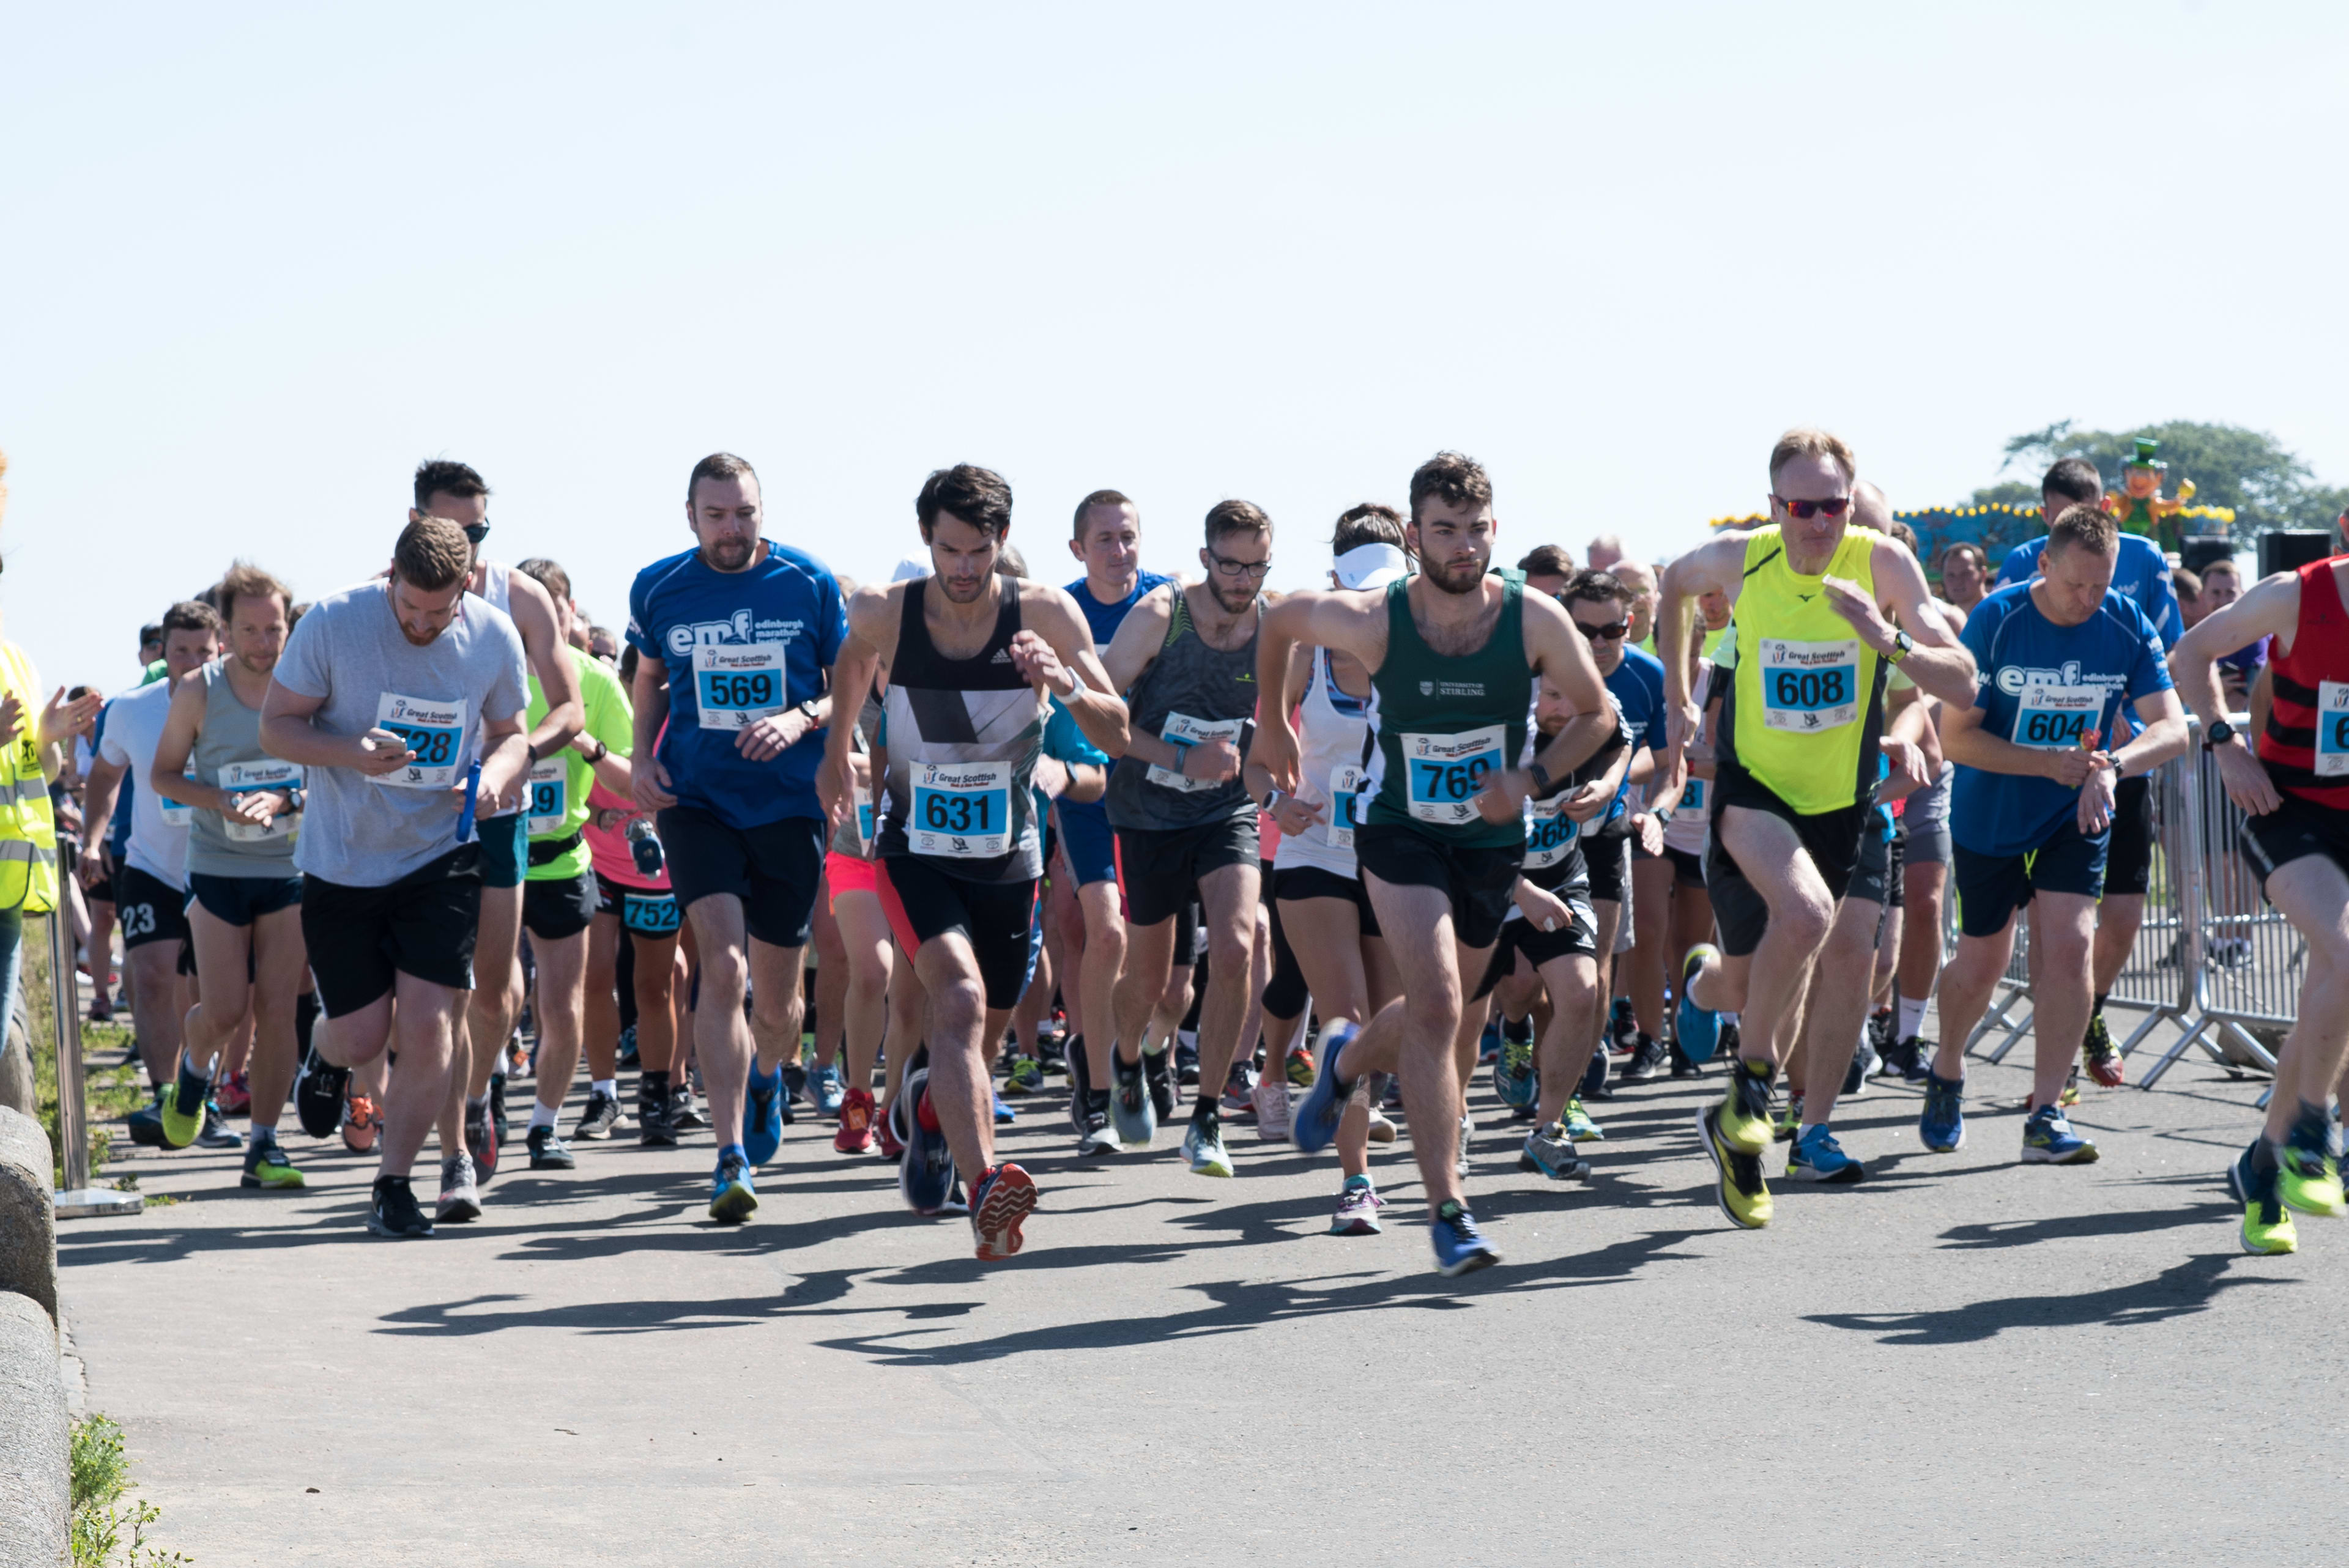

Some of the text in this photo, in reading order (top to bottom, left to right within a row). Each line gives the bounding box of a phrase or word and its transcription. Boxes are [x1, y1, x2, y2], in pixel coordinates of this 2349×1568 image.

[667, 608, 752, 656] emf
[755, 619, 804, 629] edinburgh
[755, 628, 801, 637] marathon
[711, 674, 771, 706] 569
[1439, 687, 1485, 696] STIRLING
[1776, 671, 1844, 708] 608
[1996, 660, 2080, 697] emf
[2082, 672, 2127, 683] edinburgh
[2028, 713, 2087, 742] 604
[938, 772, 996, 783] Great Scottish
[1421, 758, 1489, 799] 769
[926, 793, 989, 832] 631
[122, 902, 156, 939] 23
[625, 900, 675, 926] 752
